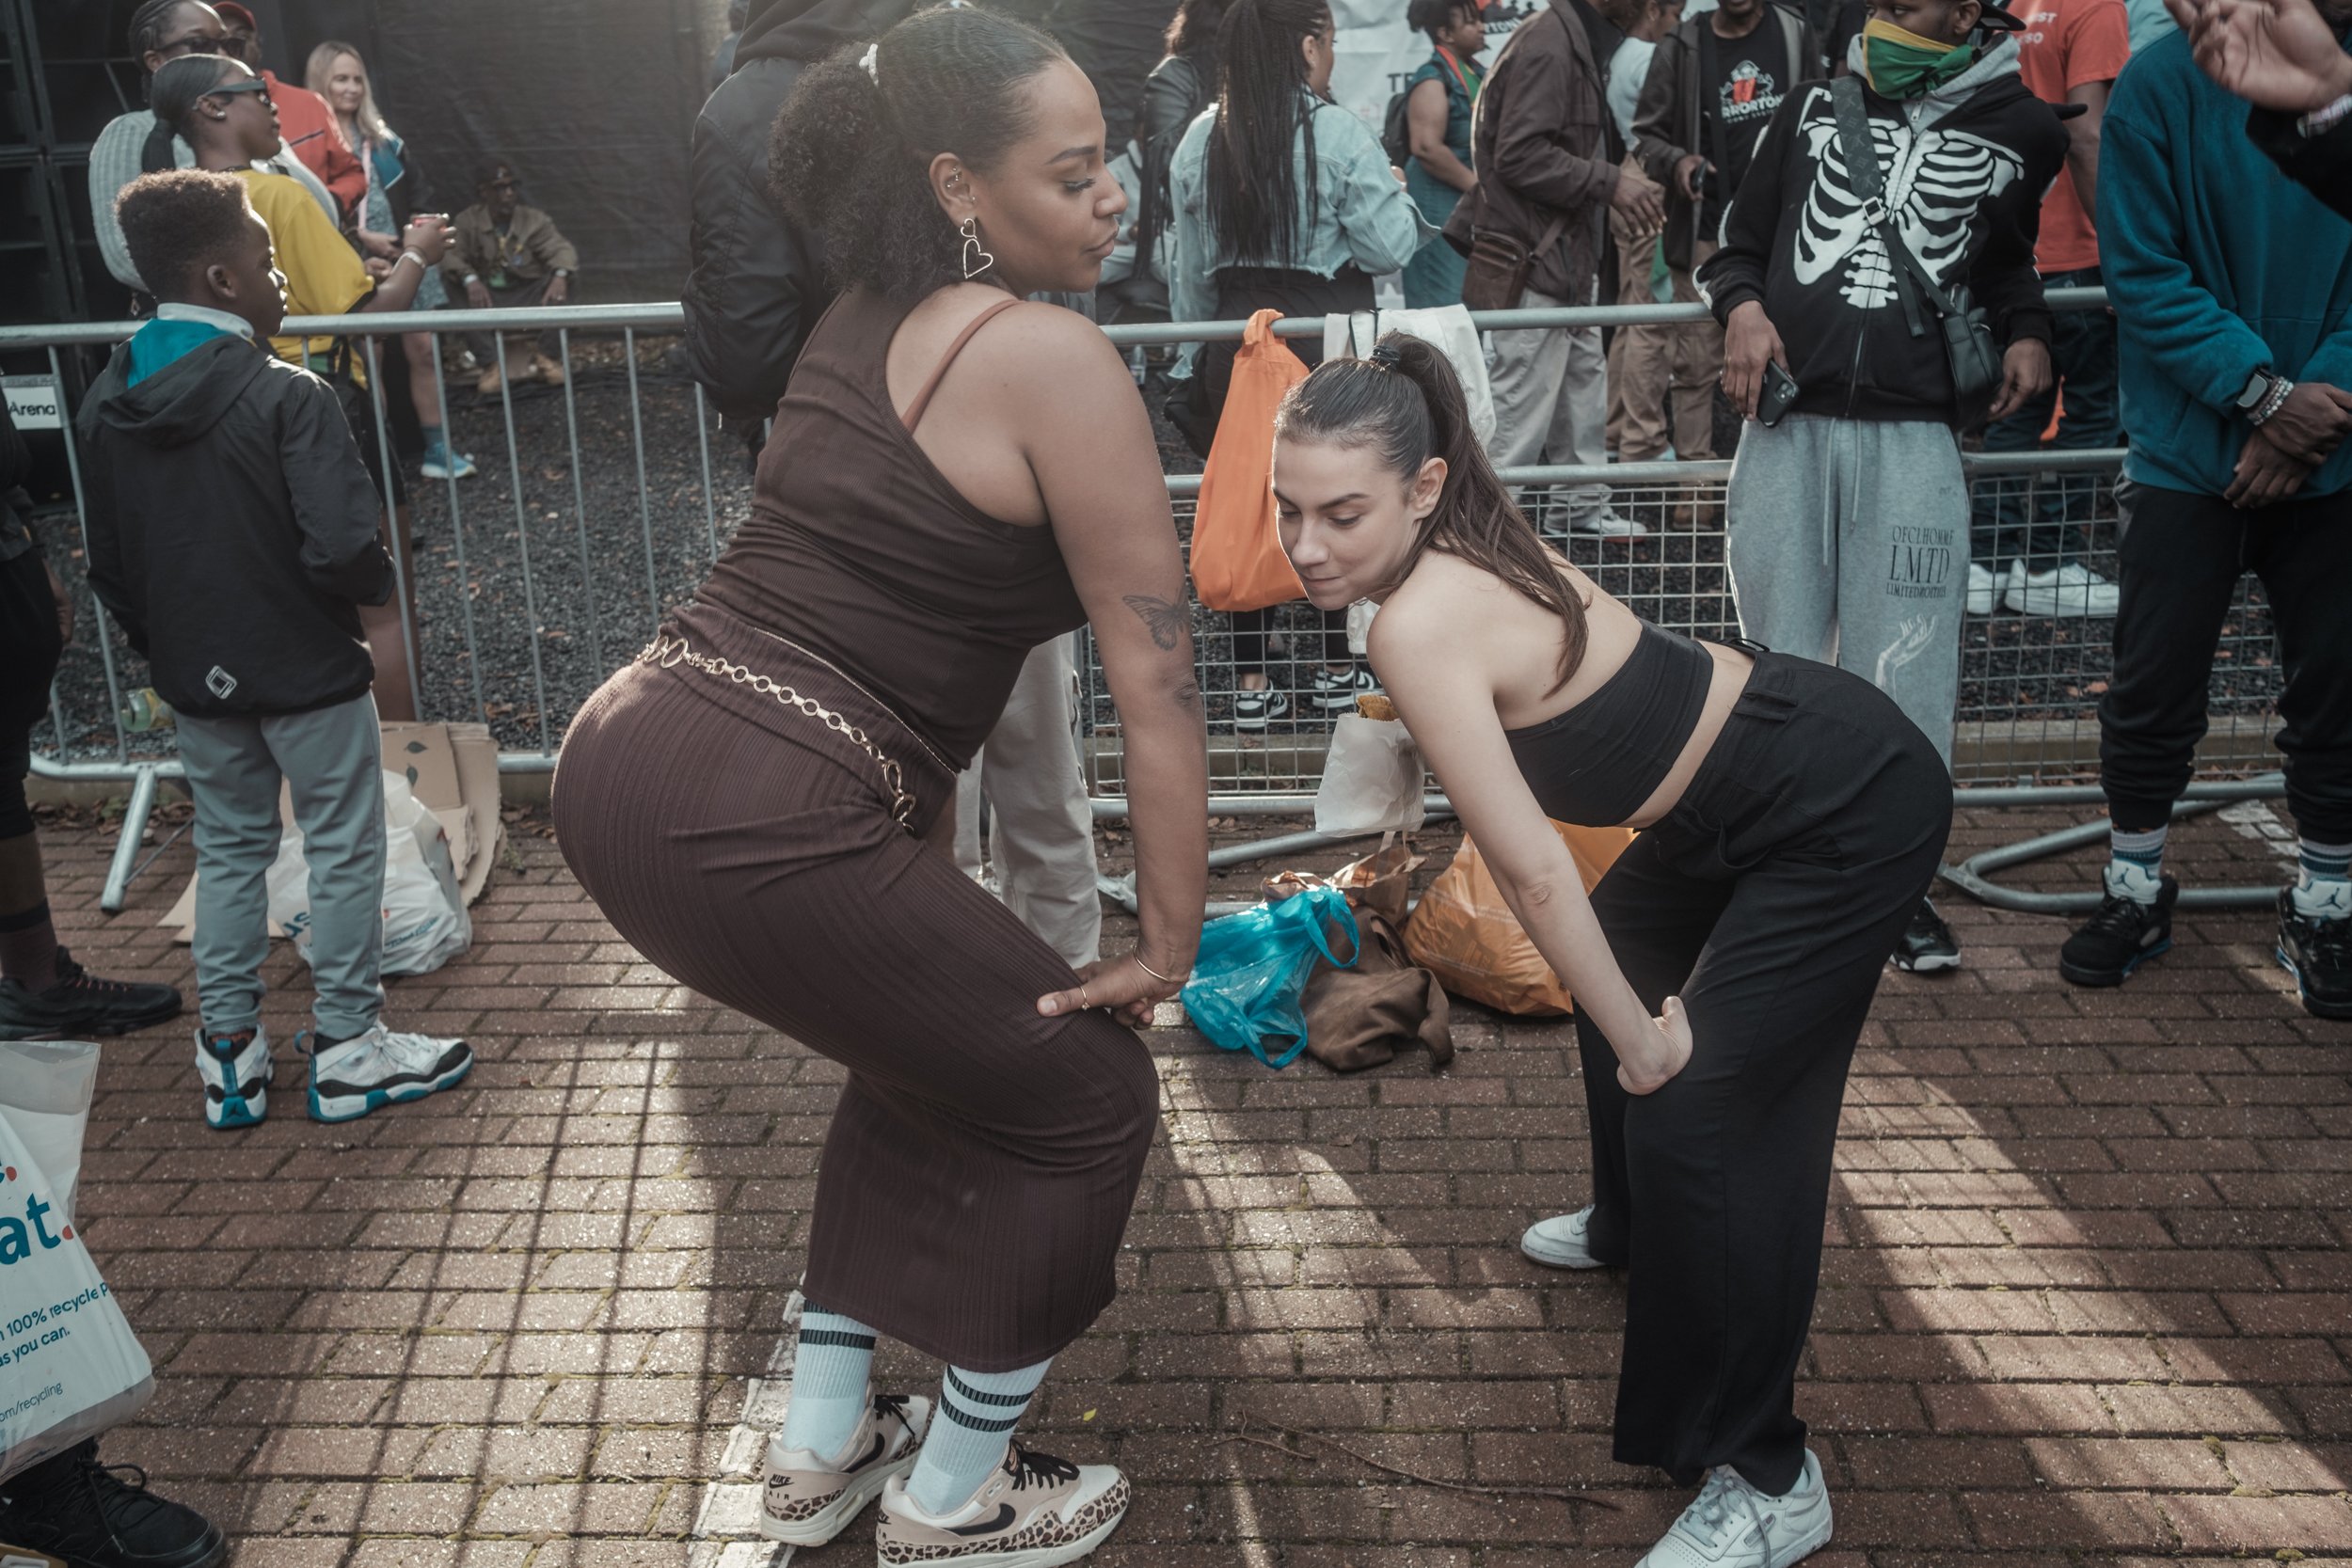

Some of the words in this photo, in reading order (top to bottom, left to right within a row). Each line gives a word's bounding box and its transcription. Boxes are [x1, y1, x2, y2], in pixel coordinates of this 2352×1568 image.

[8, 401, 56, 417] Arena
[1889, 545, 1950, 583] LMTD
[7, 1307, 48, 1337] 100%
[49, 1288, 99, 1319] recycle
[12, 1338, 39, 1363] you
[40, 1326, 71, 1345] can.
[771, 1473, 792, 1484] NIKE
[768, 1490, 790, 1501] AIR
